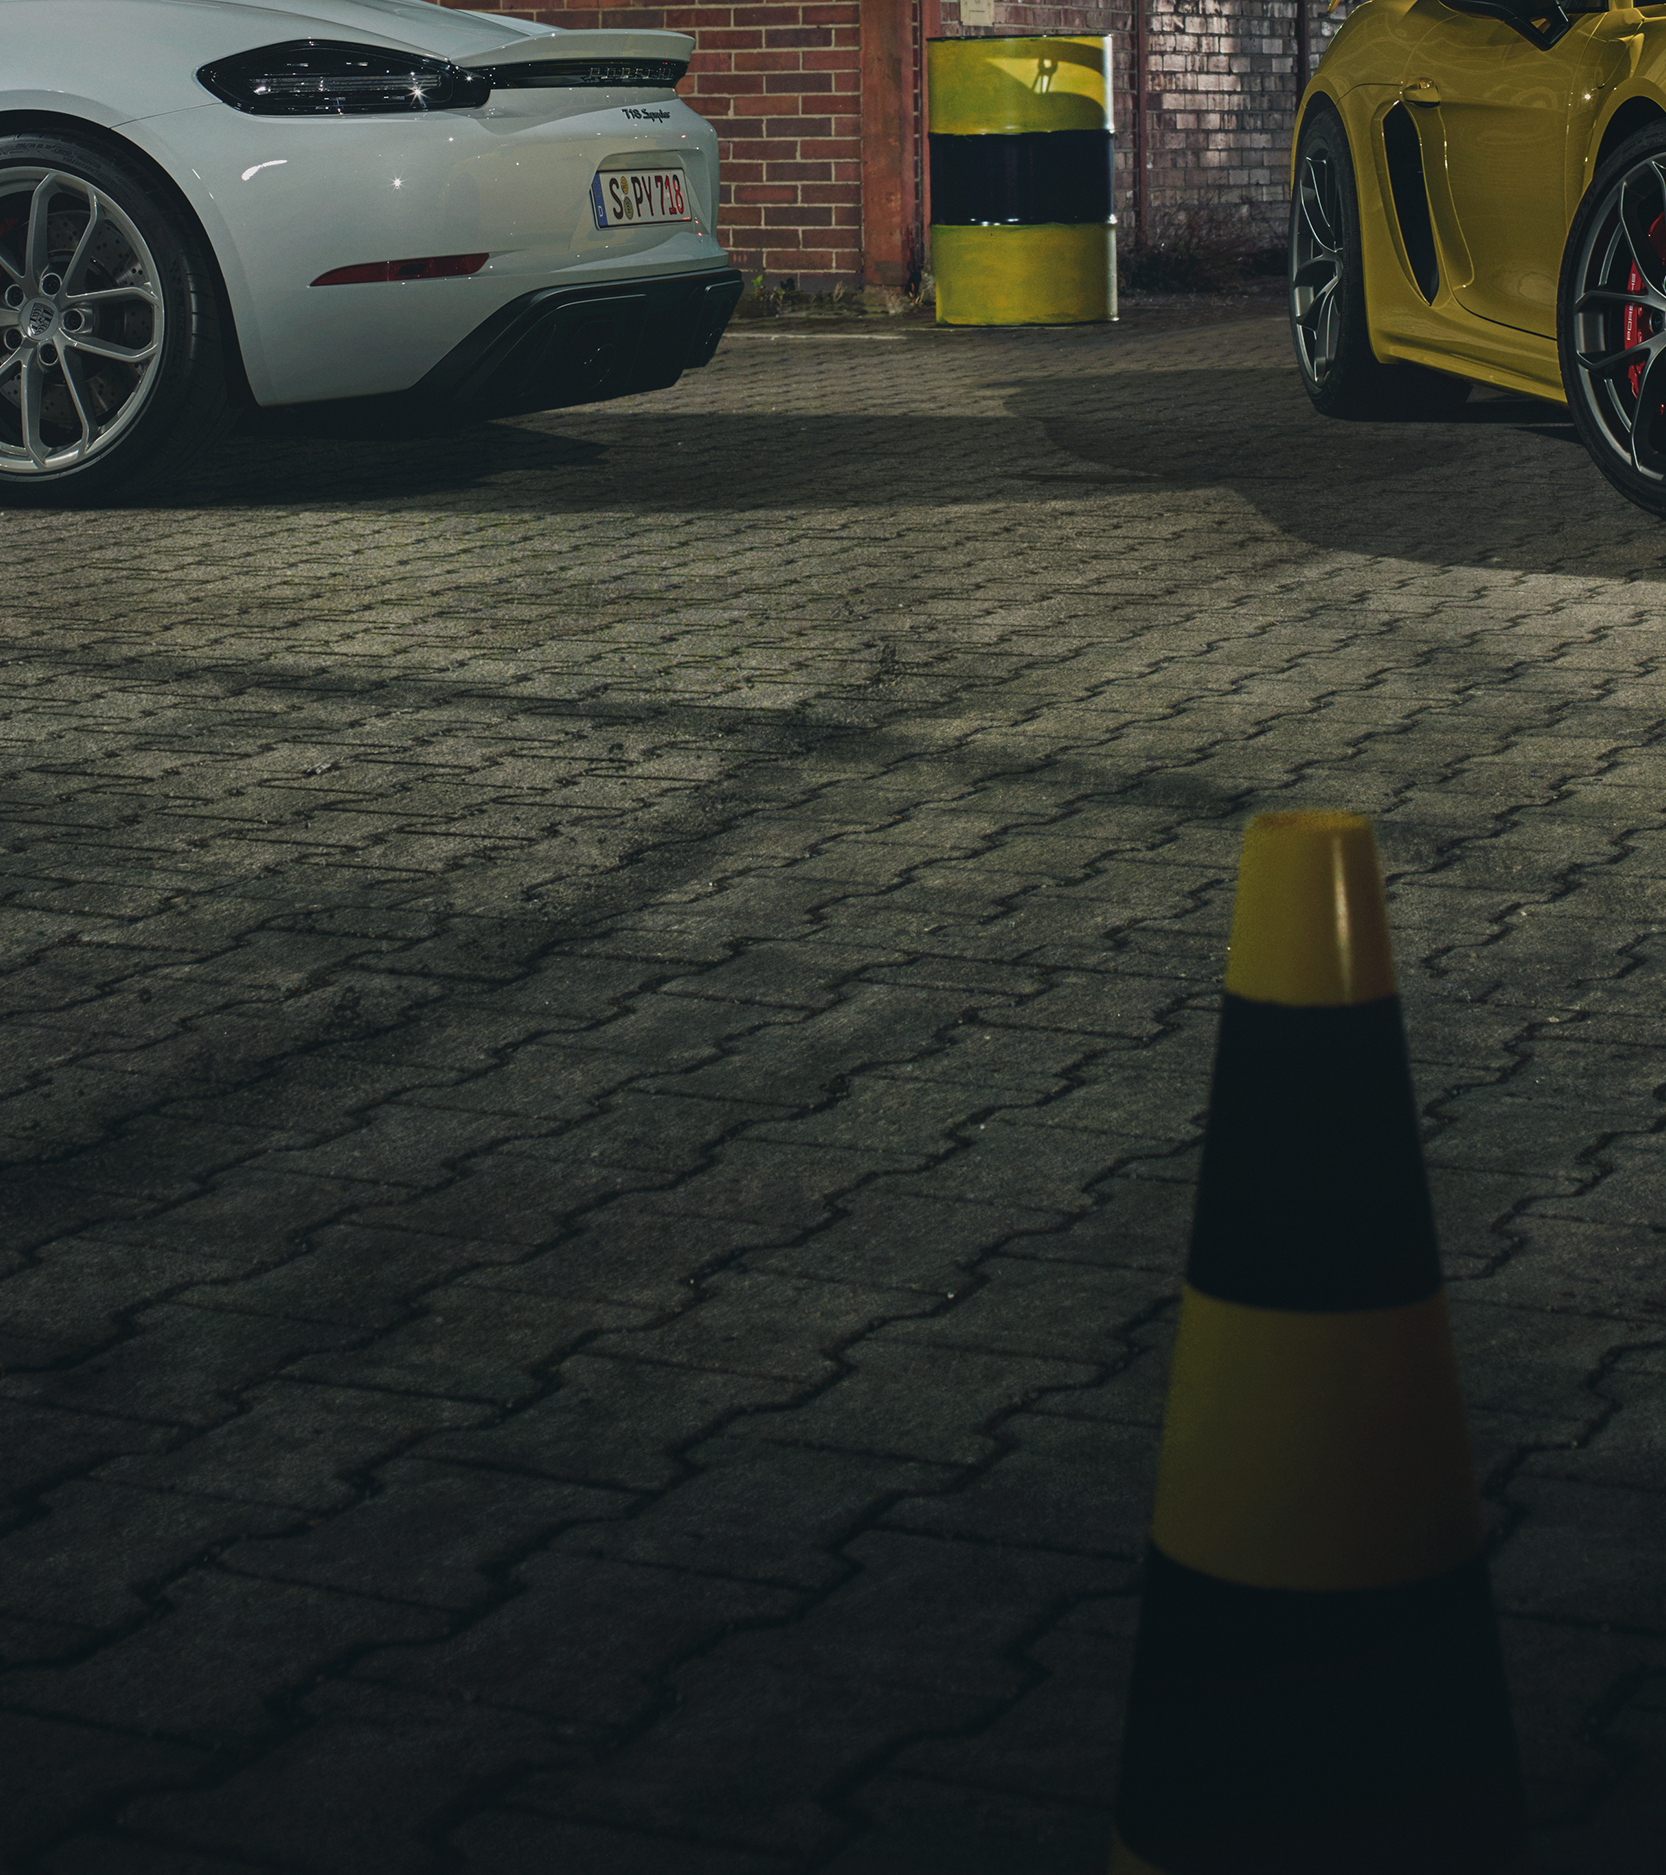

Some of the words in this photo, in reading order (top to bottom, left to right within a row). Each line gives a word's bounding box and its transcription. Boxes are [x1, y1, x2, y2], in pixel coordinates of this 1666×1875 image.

[621, 108, 642, 120] 718
[642, 108, 671, 124] Spyder
[597, 205, 604, 217] D
[608, 177, 624, 220] S
[1626, 273, 1636, 341] PORSHE
